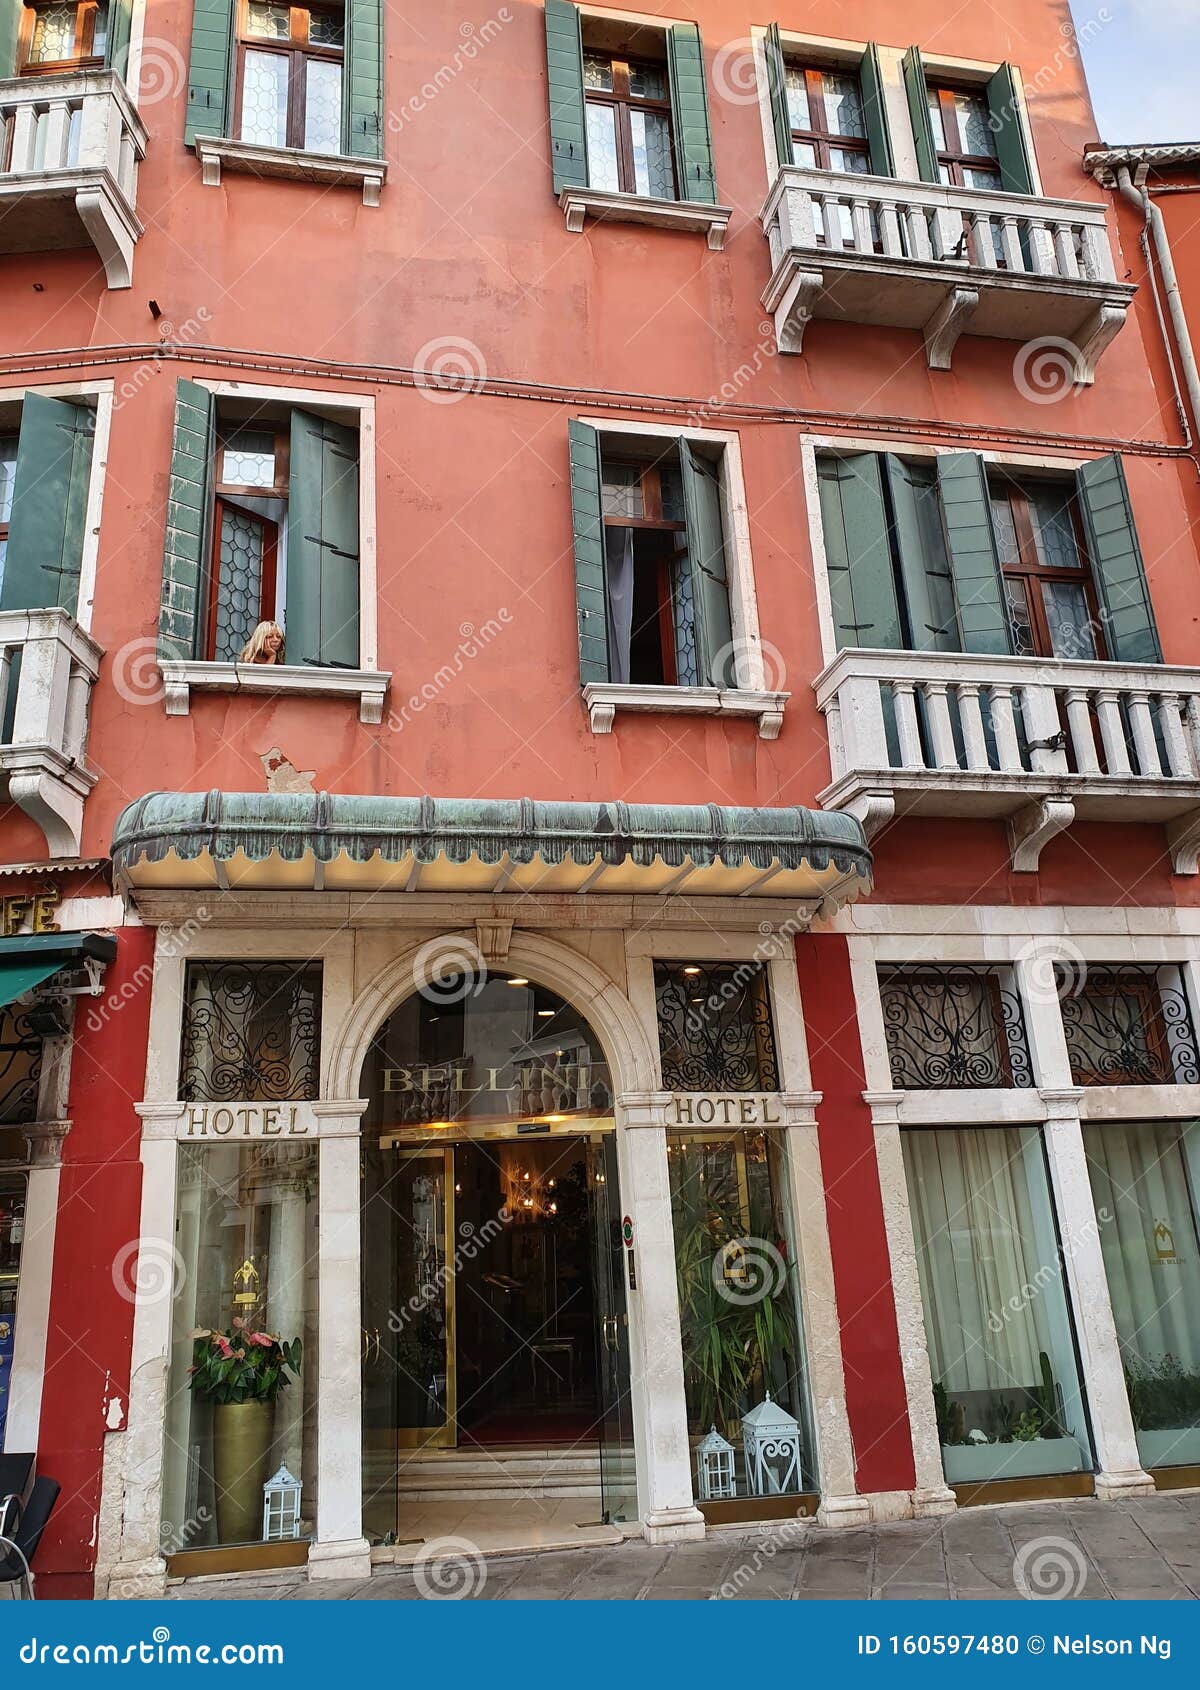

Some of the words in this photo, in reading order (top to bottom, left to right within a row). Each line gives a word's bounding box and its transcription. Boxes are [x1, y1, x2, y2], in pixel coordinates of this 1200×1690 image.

[0, 880, 61, 935] FÈ
[378, 1067, 593, 1093] BELLINI
[187, 1106, 308, 1135] HOTEL
[675, 1098, 780, 1123] HOTEL
